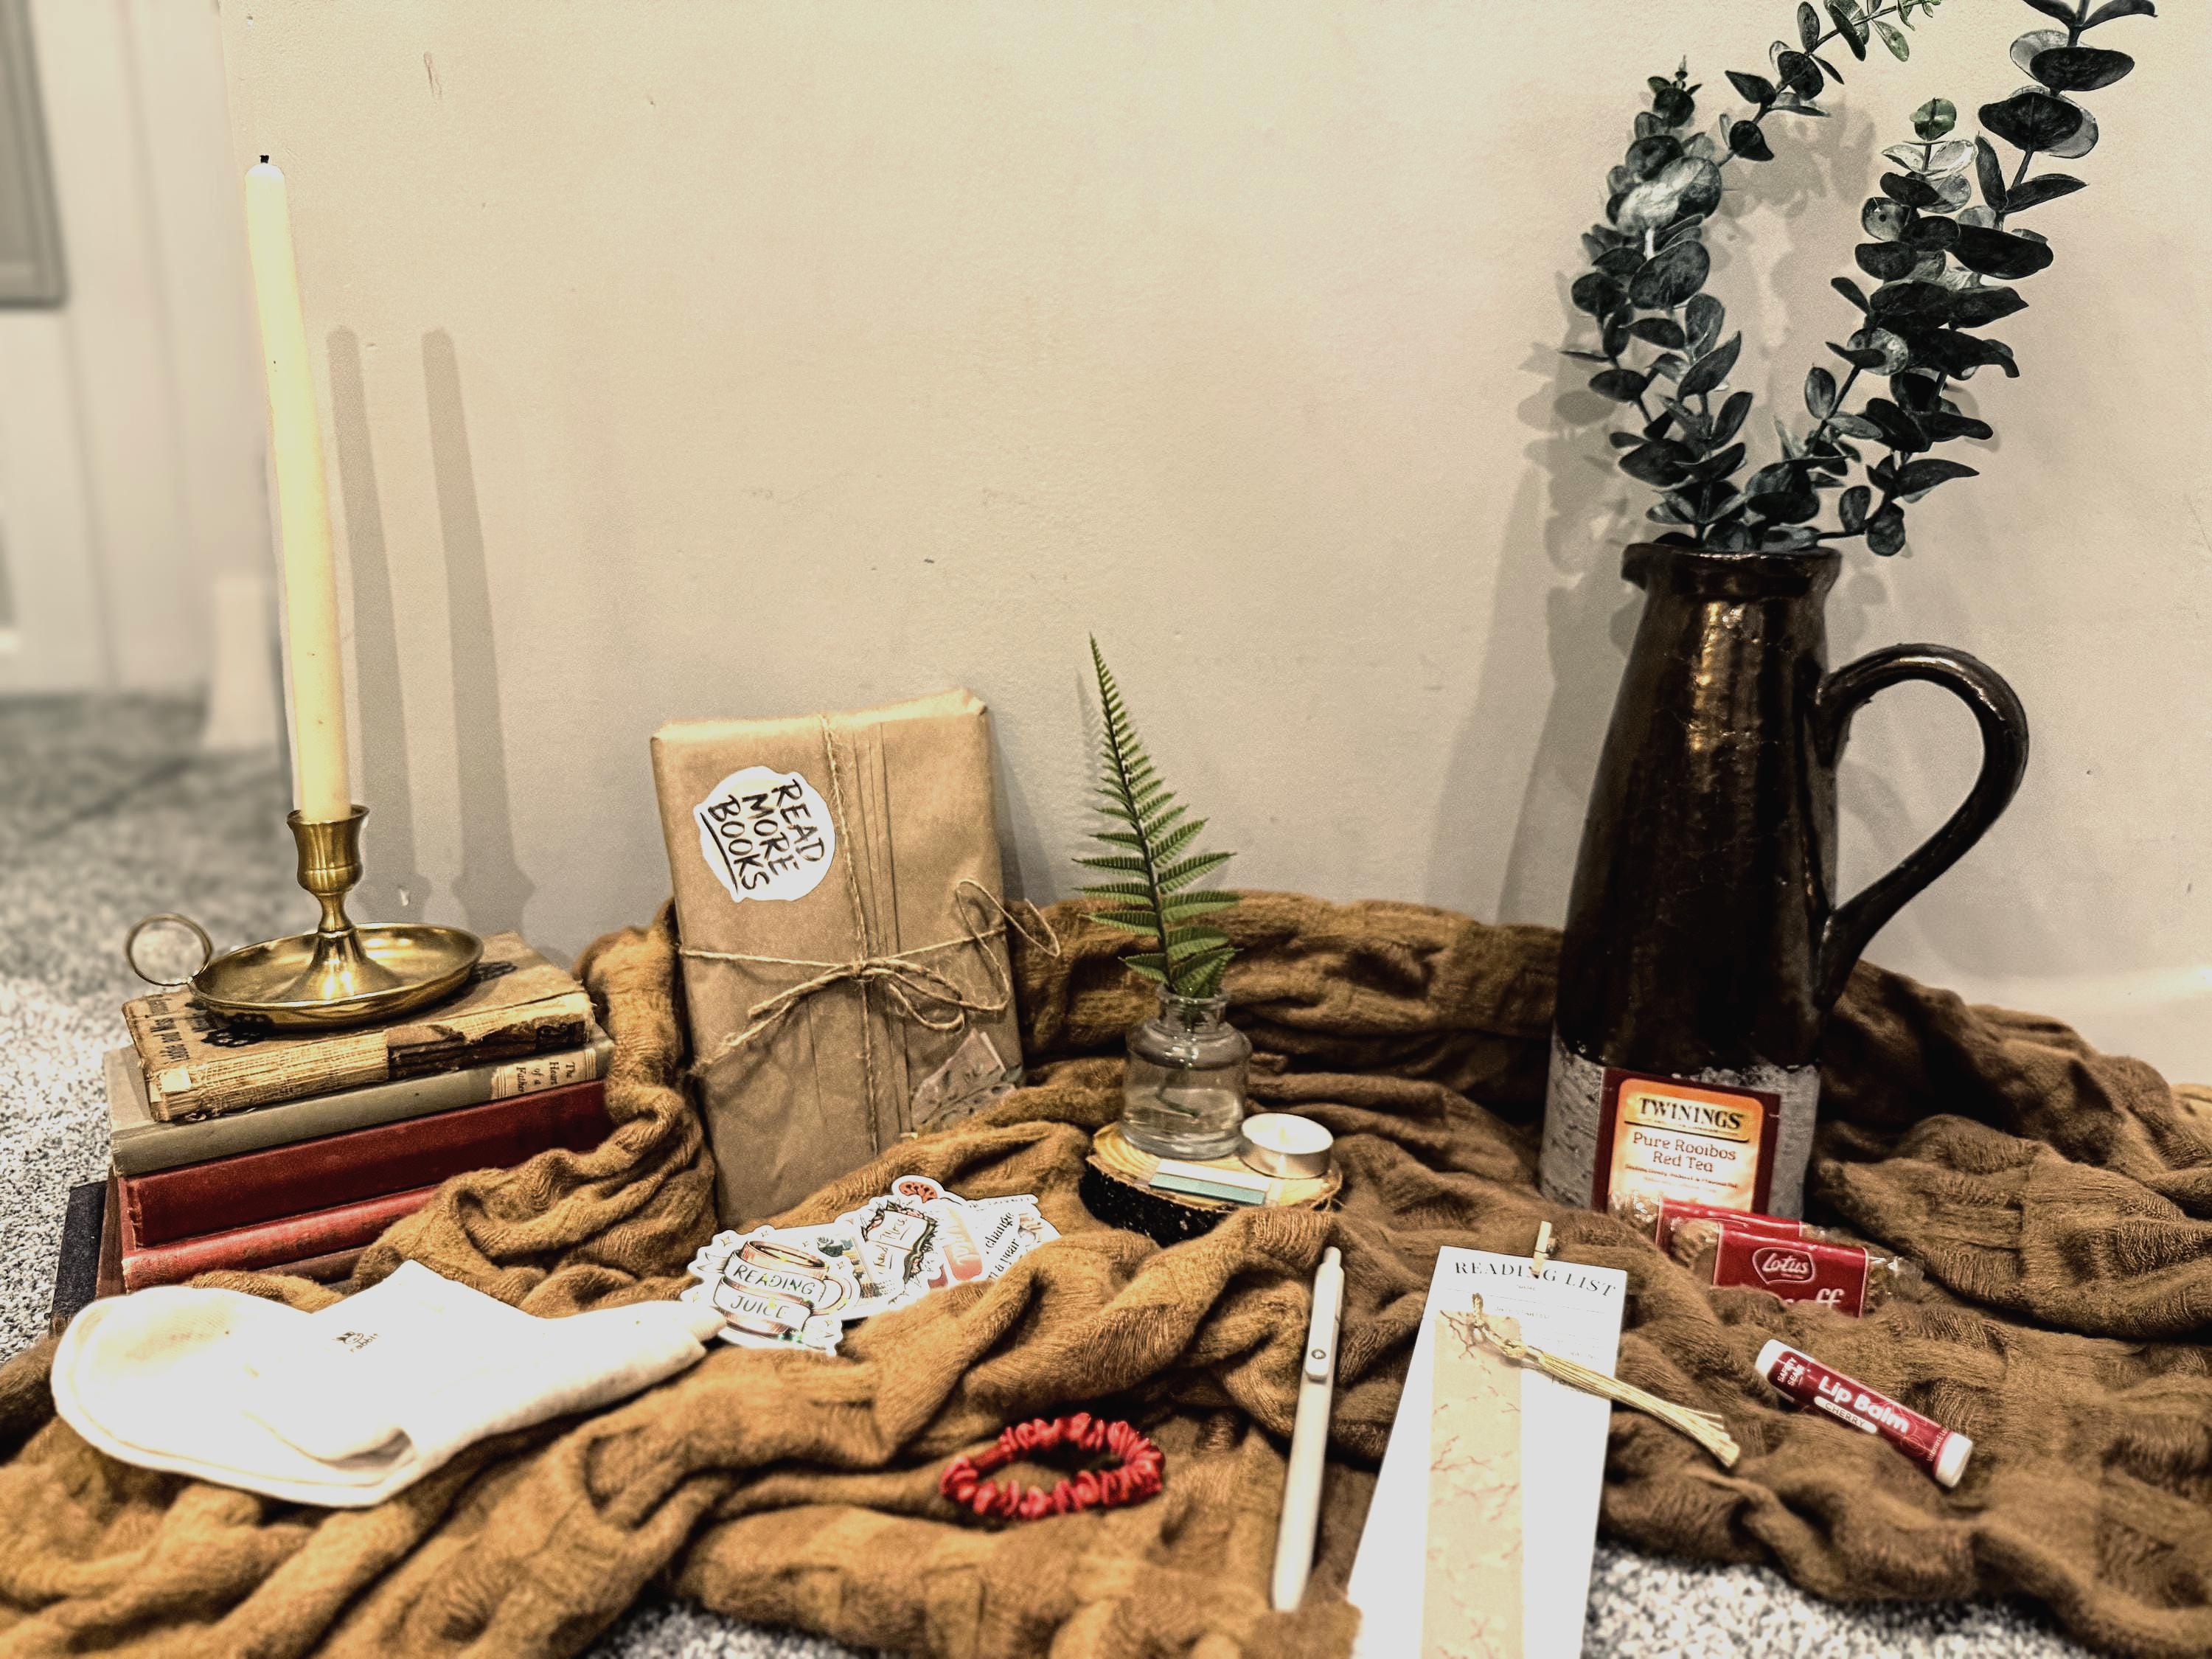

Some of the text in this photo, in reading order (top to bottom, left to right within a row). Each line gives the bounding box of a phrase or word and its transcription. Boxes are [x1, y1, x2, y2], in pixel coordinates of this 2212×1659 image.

[742, 793, 800, 876] MORE
[771, 779, 825, 861] READ
[707, 794, 770, 890] BOOKS
[566, 1061, 576, 1079] The
[1639, 1096, 1745, 1131] TWININGS
[1632, 1131, 1737, 1161] Pure Rooibos
[1652, 1150, 1714, 1173] Red Tea
[1761, 1253, 1810, 1274] Lotus
[733, 1264, 816, 1295] READING
[1565, 1273, 1617, 1298] LIST
[730, 1295, 791, 1319] JUICE
[1818, 1375, 1909, 1433] Lip Balm
[1825, 1402, 1865, 1427] CHERRY
